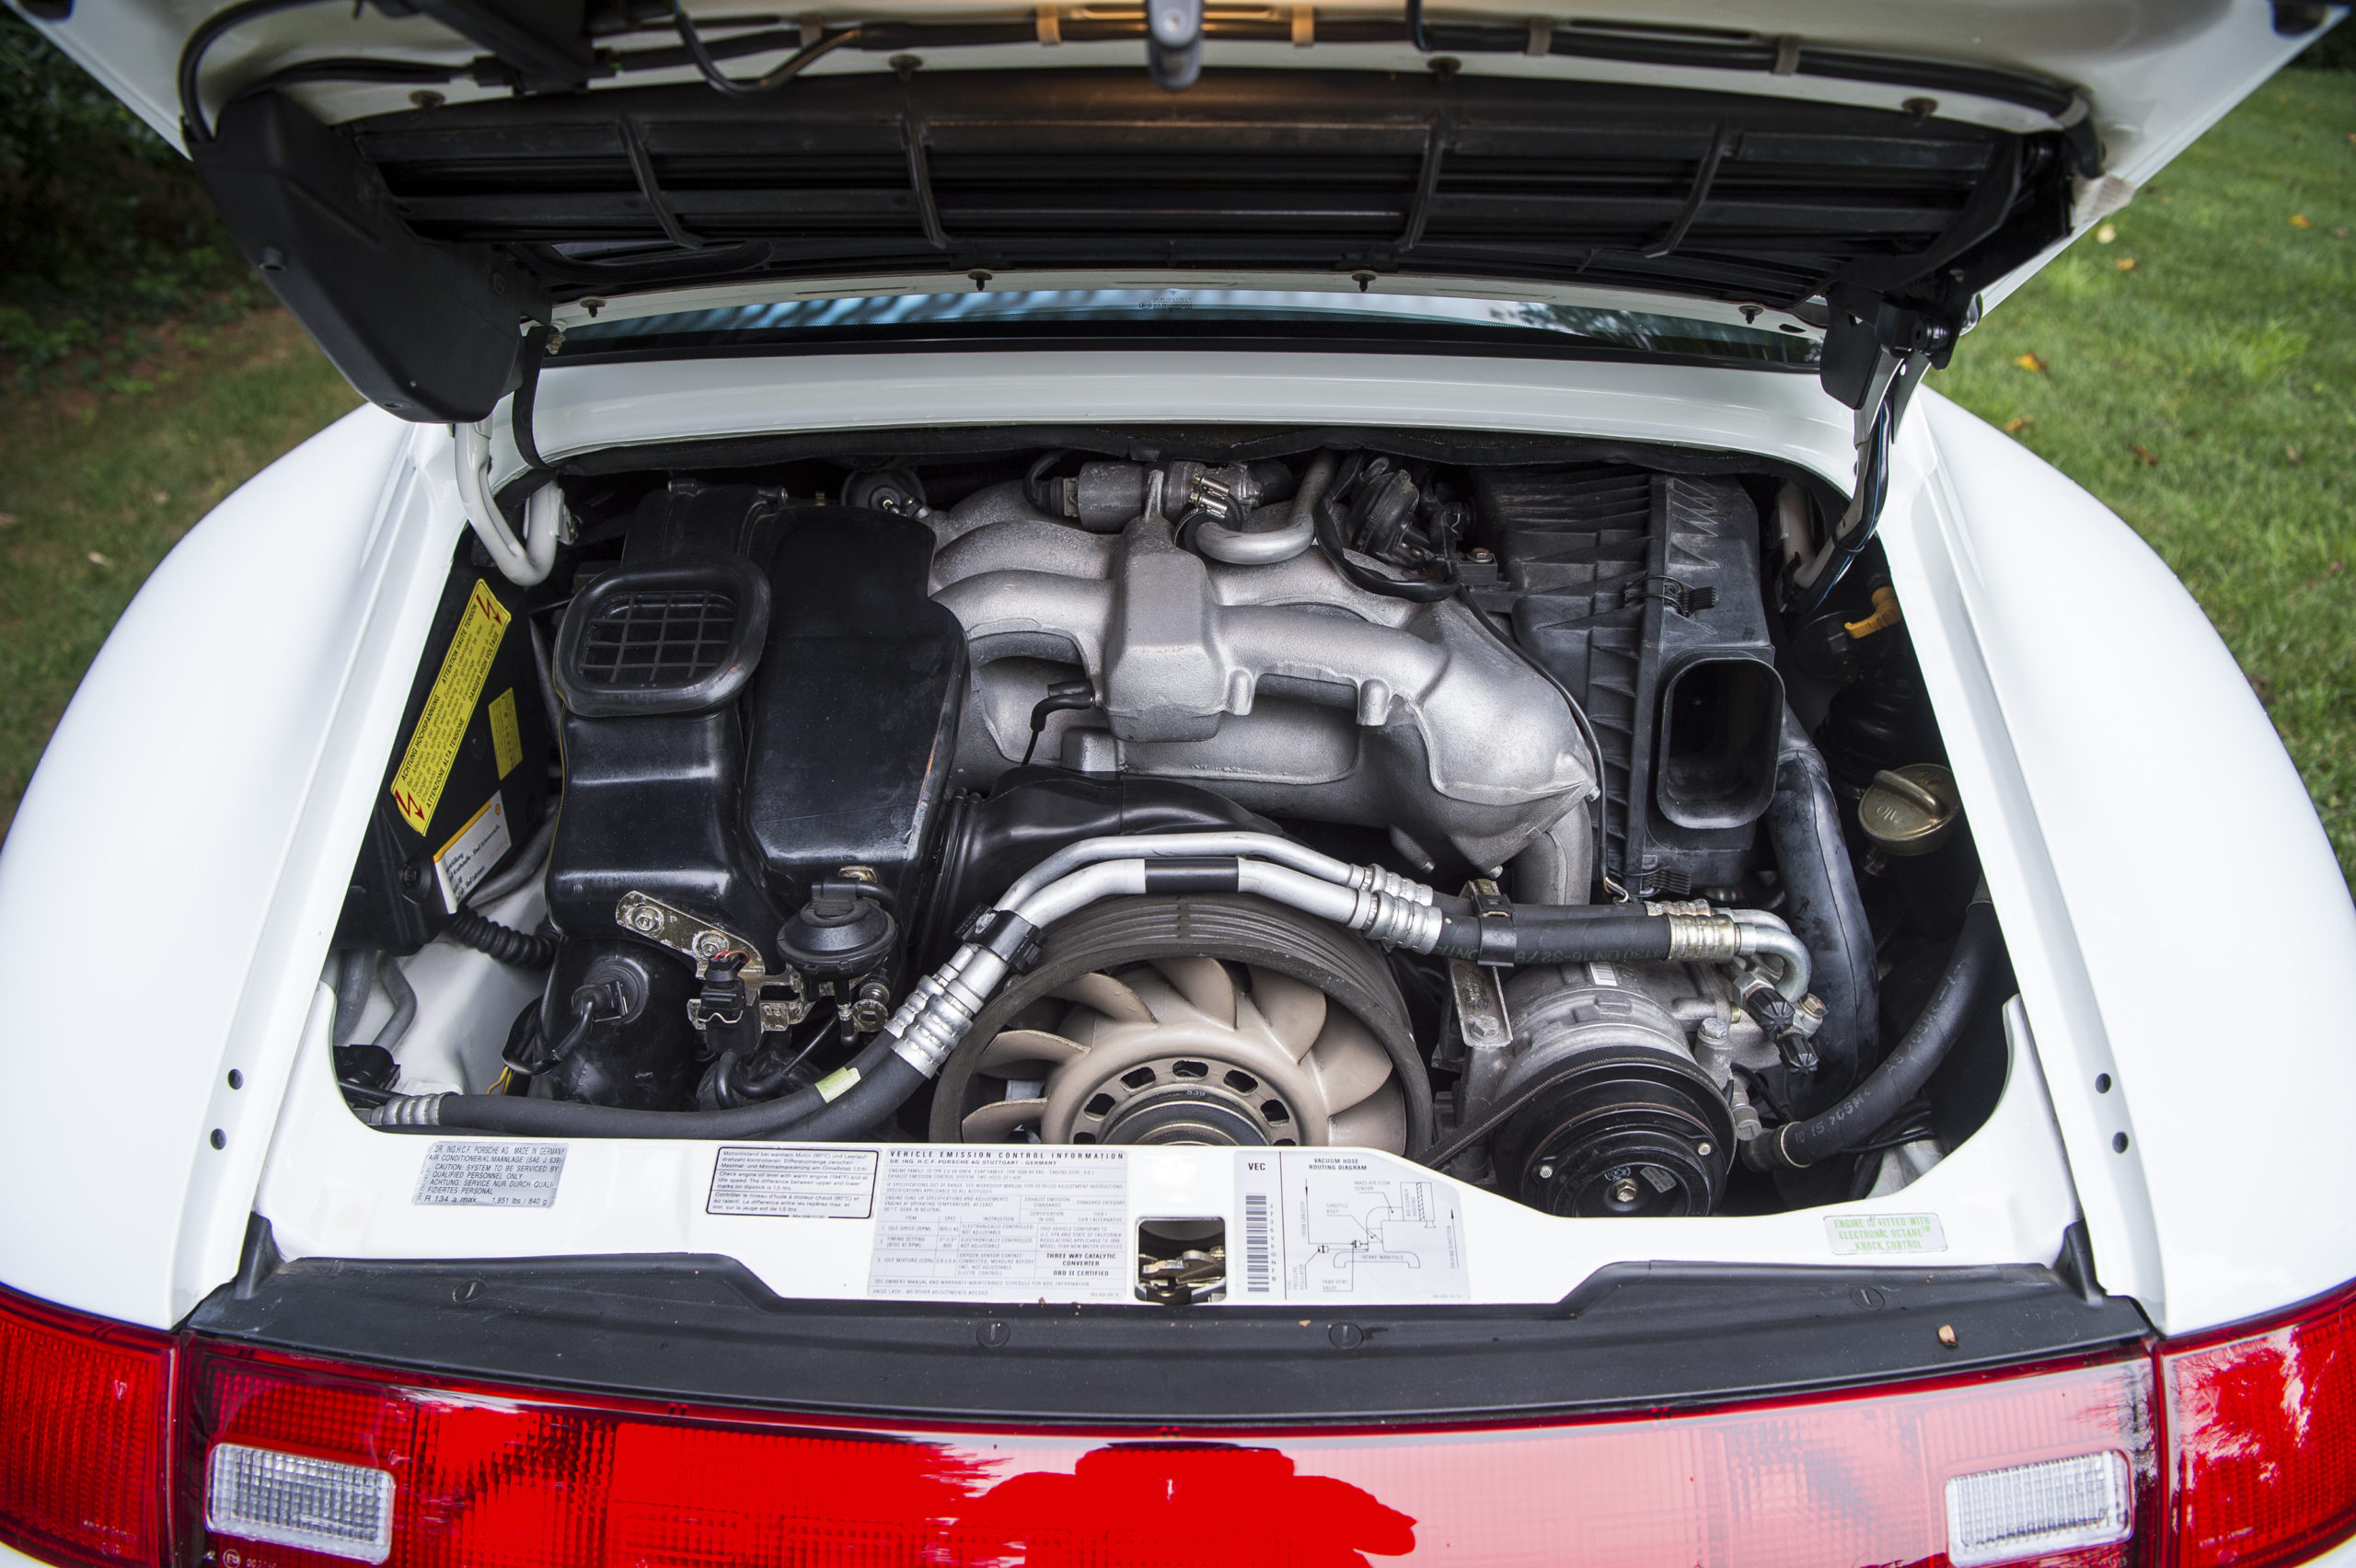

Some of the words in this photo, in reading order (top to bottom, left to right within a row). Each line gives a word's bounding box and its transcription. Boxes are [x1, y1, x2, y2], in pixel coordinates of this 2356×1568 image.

[442, 649, 458, 685] ATTENTION
[455, 629, 468, 651] HAUTE
[465, 604, 477, 629] TENSION
[468, 675, 481, 702] DANGER
[485, 631, 499, 660] VOLTAGE
[401, 747, 418, 781] ACHTUNG
[415, 694, 440, 748] HOCHSPANNUNG
[426, 768, 445, 809] ATTENZIONE
[443, 749, 452, 767] ALTA
[449, 718, 465, 751] TENSIONE
[514, 1147, 529, 1155] MADE
[1909, 1216, 1931, 1226] WITH
